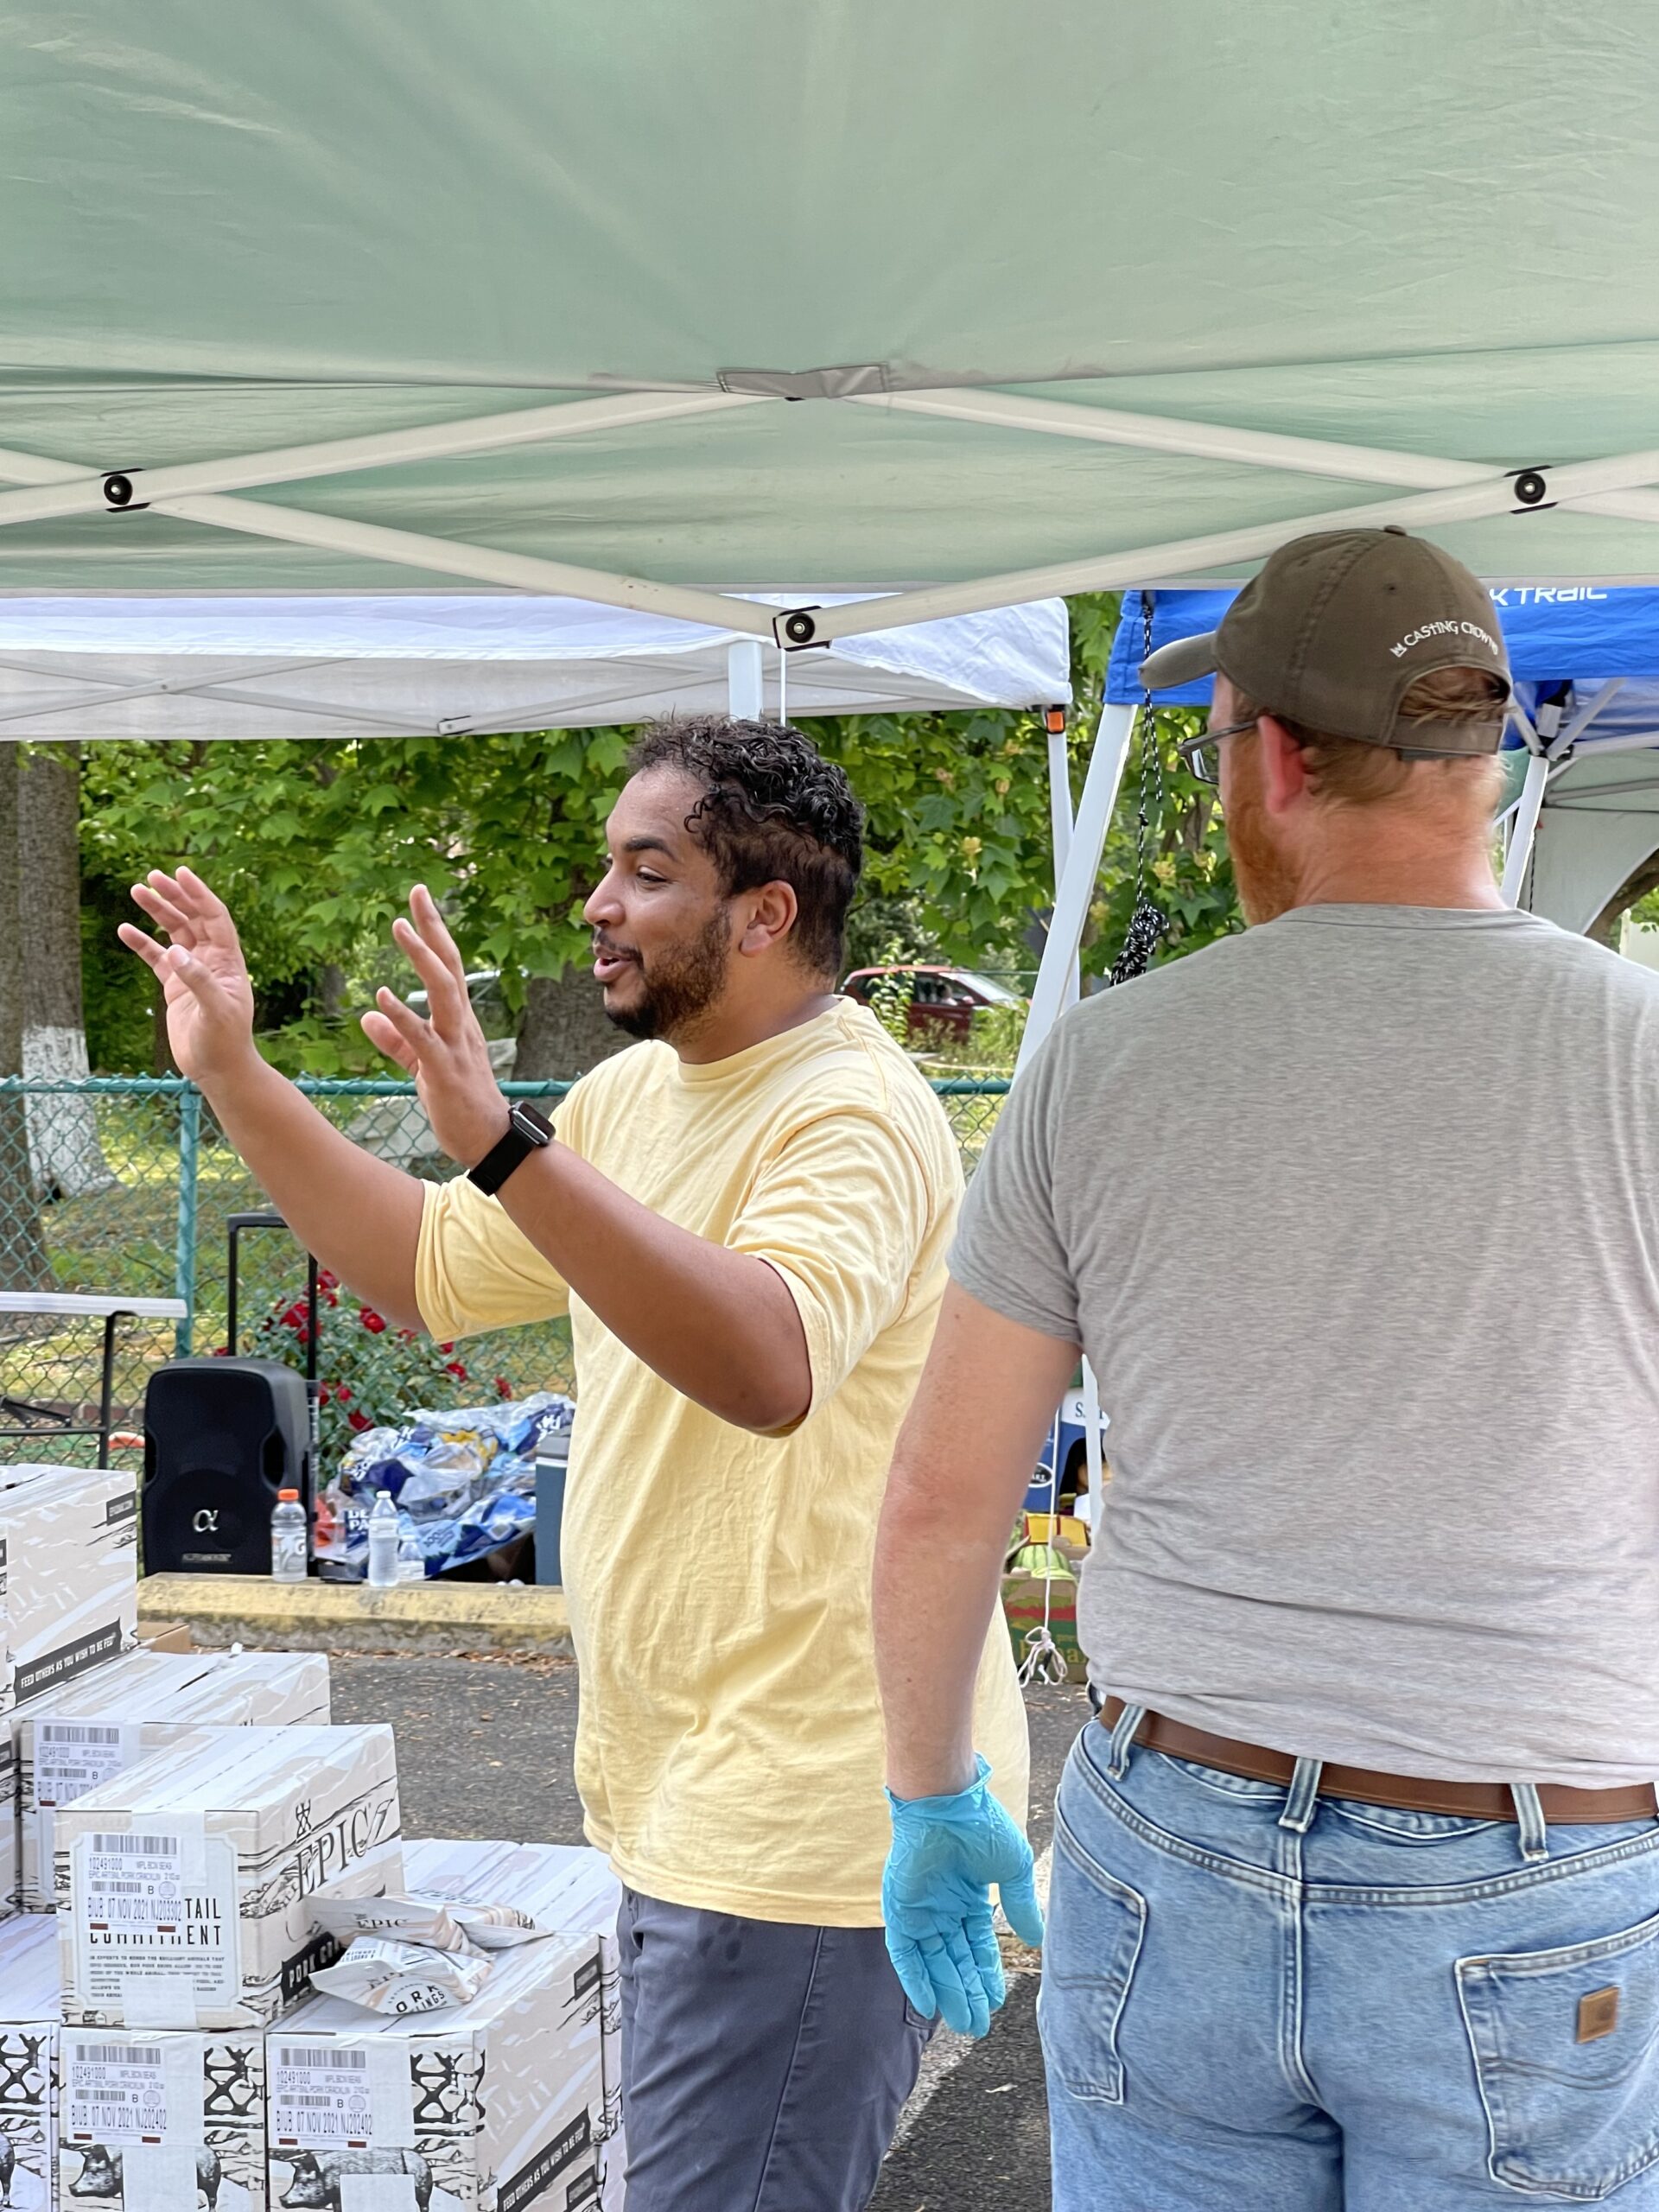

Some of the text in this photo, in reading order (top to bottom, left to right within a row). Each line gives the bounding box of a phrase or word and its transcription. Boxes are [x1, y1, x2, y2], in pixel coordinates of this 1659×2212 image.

[1403, 620, 1498, 655] CASTING CROWNS
[21, 1674, 35, 1688] FEED
[63, 1654, 74, 1669] YOU
[74, 1648, 88, 1663] WISH
[89, 1643, 96, 1656] TO
[96, 1641, 104, 1653] BE
[295, 1807, 370, 1902] EPIC
[148, 1885, 155, 1895] B
[107, 1897, 115, 1918] 07
[118, 1898, 131, 1919] NOV
[133, 1899, 149, 1920] 2021
[184, 1897, 222, 1919] TAIL
[355, 1918, 406, 1929] EPIC
[410, 1990, 446, 2012] LINGS
[131, 2094, 139, 2104] B
[337, 2098, 345, 2108] B
[92, 2105, 99, 2126] 07
[101, 2106, 116, 2127] NOV
[118, 2107, 133, 2128] 2021
[296, 2111, 304, 2133] 07
[306, 2112, 321, 2133] NOV
[323, 2113, 338, 2133] 2021
